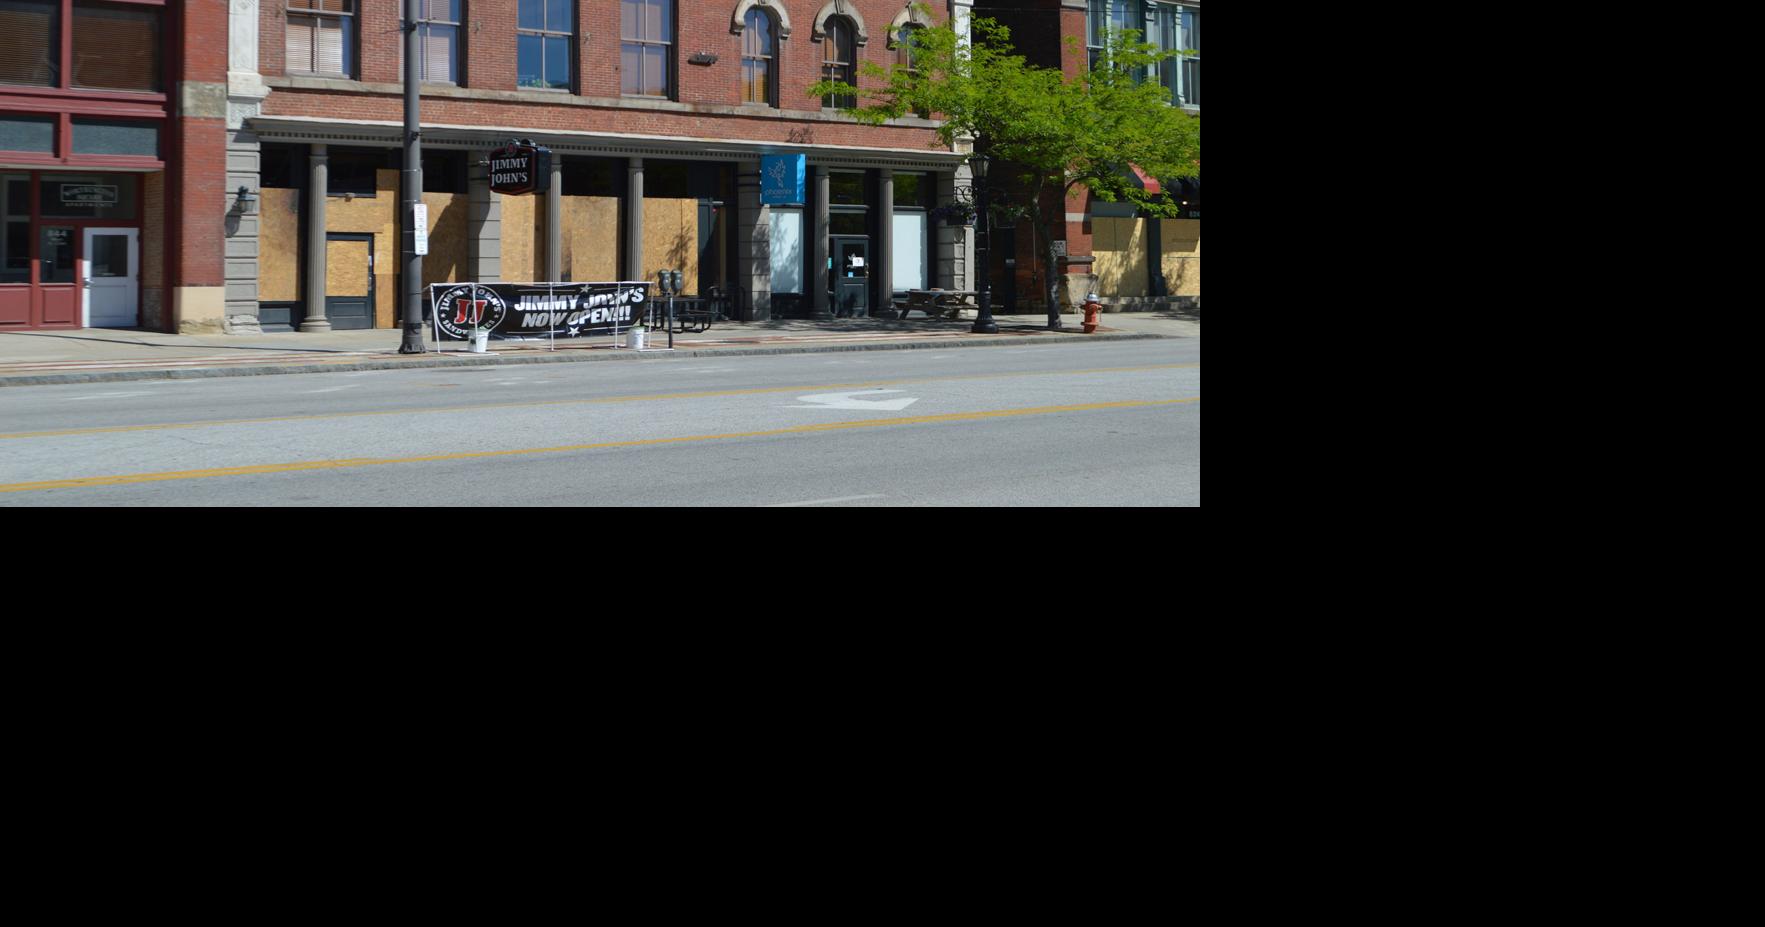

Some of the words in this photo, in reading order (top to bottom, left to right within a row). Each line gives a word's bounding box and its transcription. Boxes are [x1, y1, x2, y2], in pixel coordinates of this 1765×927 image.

[491, 157, 528, 172] JIMMY
[491, 172, 528, 187] JOHN'S
[514, 295, 580, 311] JIMMY
[454, 299, 488, 324] JJ
[521, 312, 567, 328] NOW
